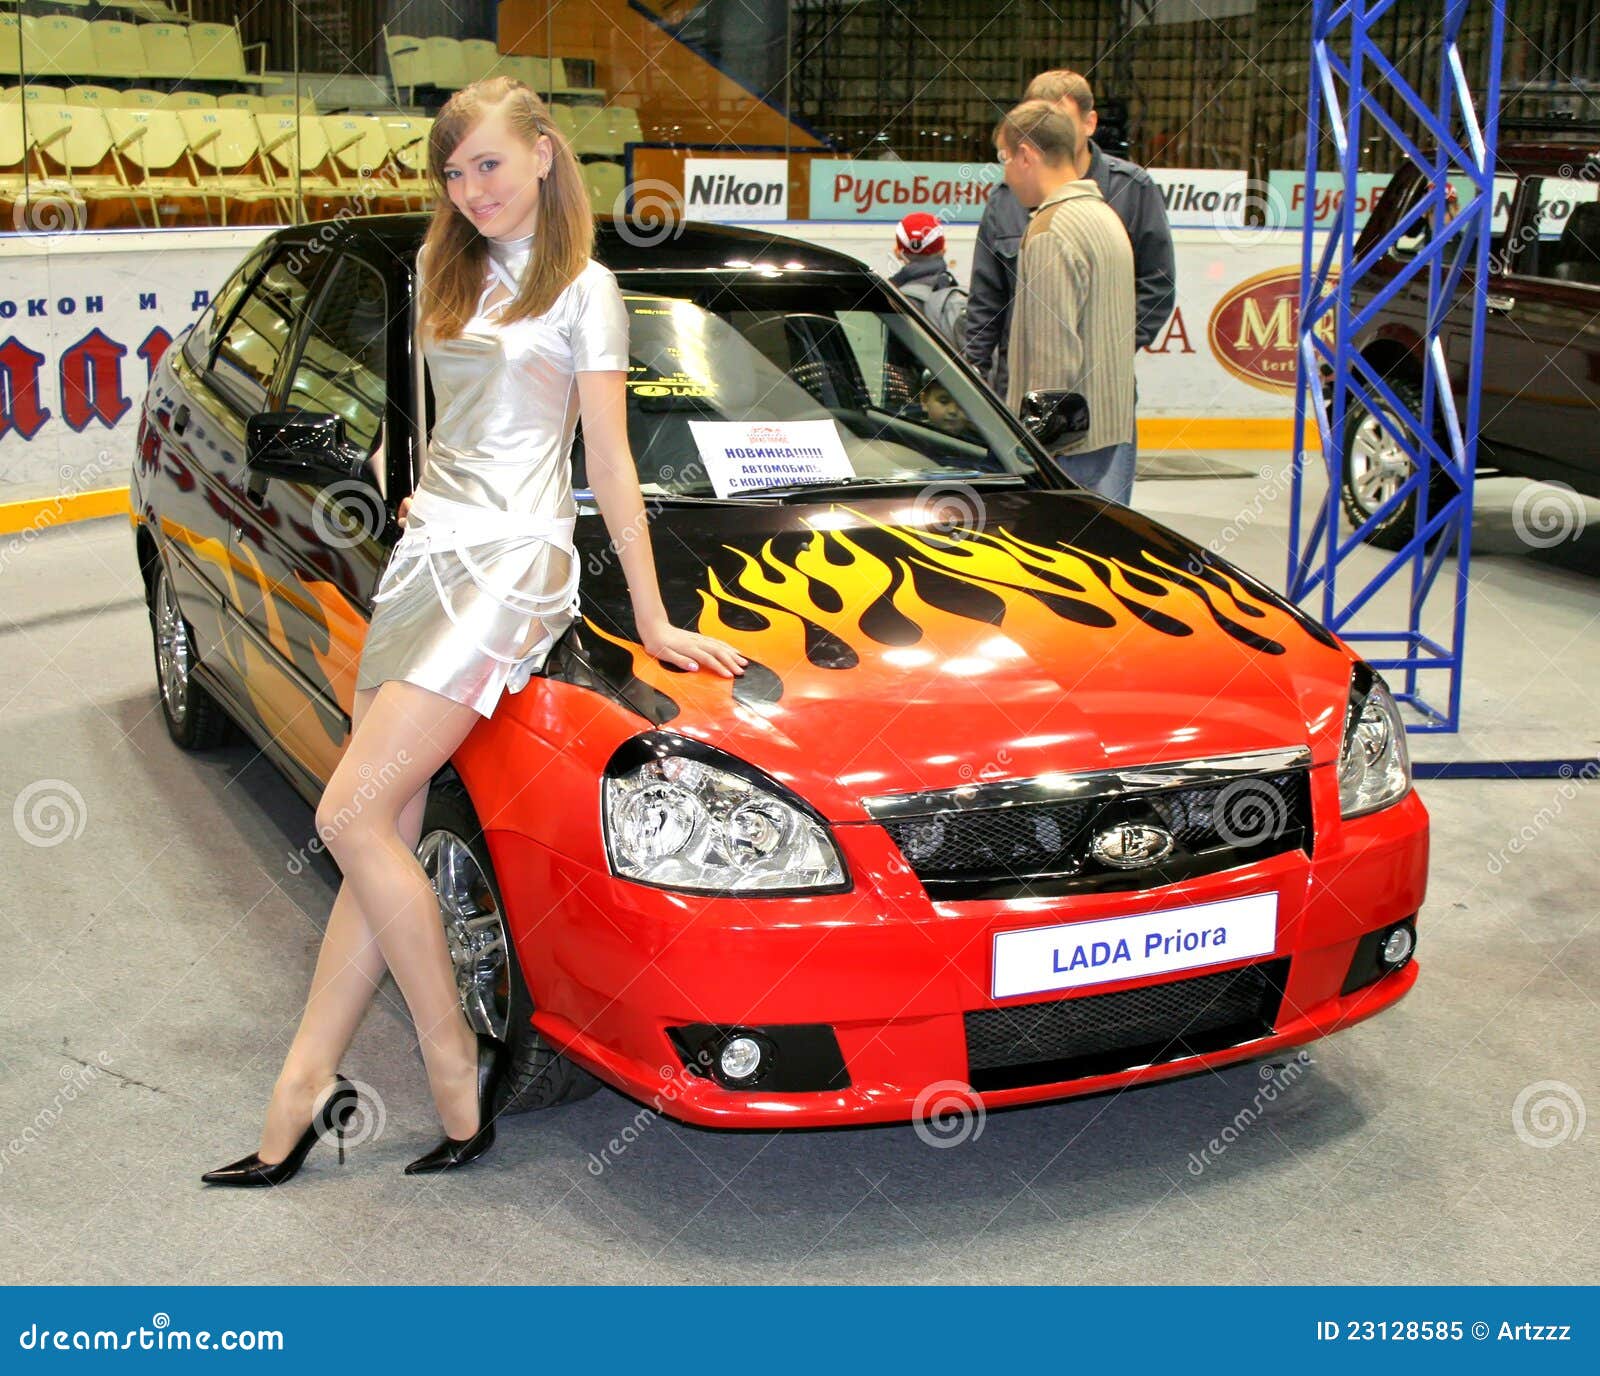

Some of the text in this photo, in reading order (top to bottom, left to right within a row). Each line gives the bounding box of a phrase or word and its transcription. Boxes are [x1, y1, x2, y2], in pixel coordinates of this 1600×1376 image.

[690, 174, 783, 206] Nikon
[833, 174, 994, 214] РусьБанк
[1053, 926, 1228, 973] LADA Priora
